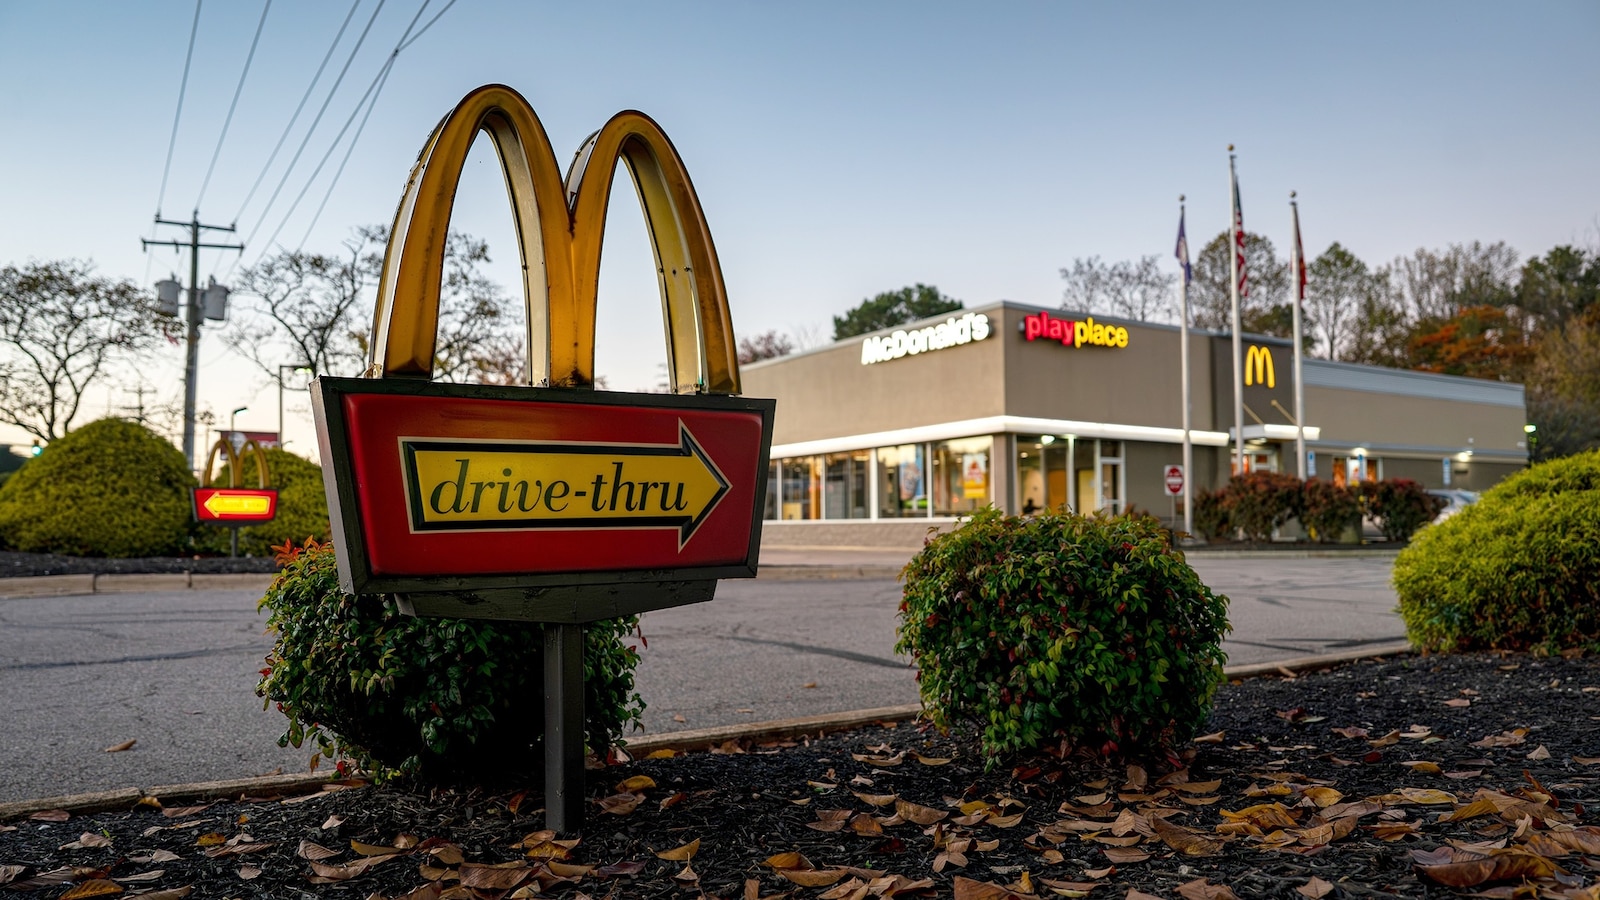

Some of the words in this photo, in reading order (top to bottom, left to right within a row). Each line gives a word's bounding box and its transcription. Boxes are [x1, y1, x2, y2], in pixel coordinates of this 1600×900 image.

[861, 312, 990, 365] McDonald's
[1025, 311, 1128, 348] playplace
[430, 458, 688, 515] drive-thru
